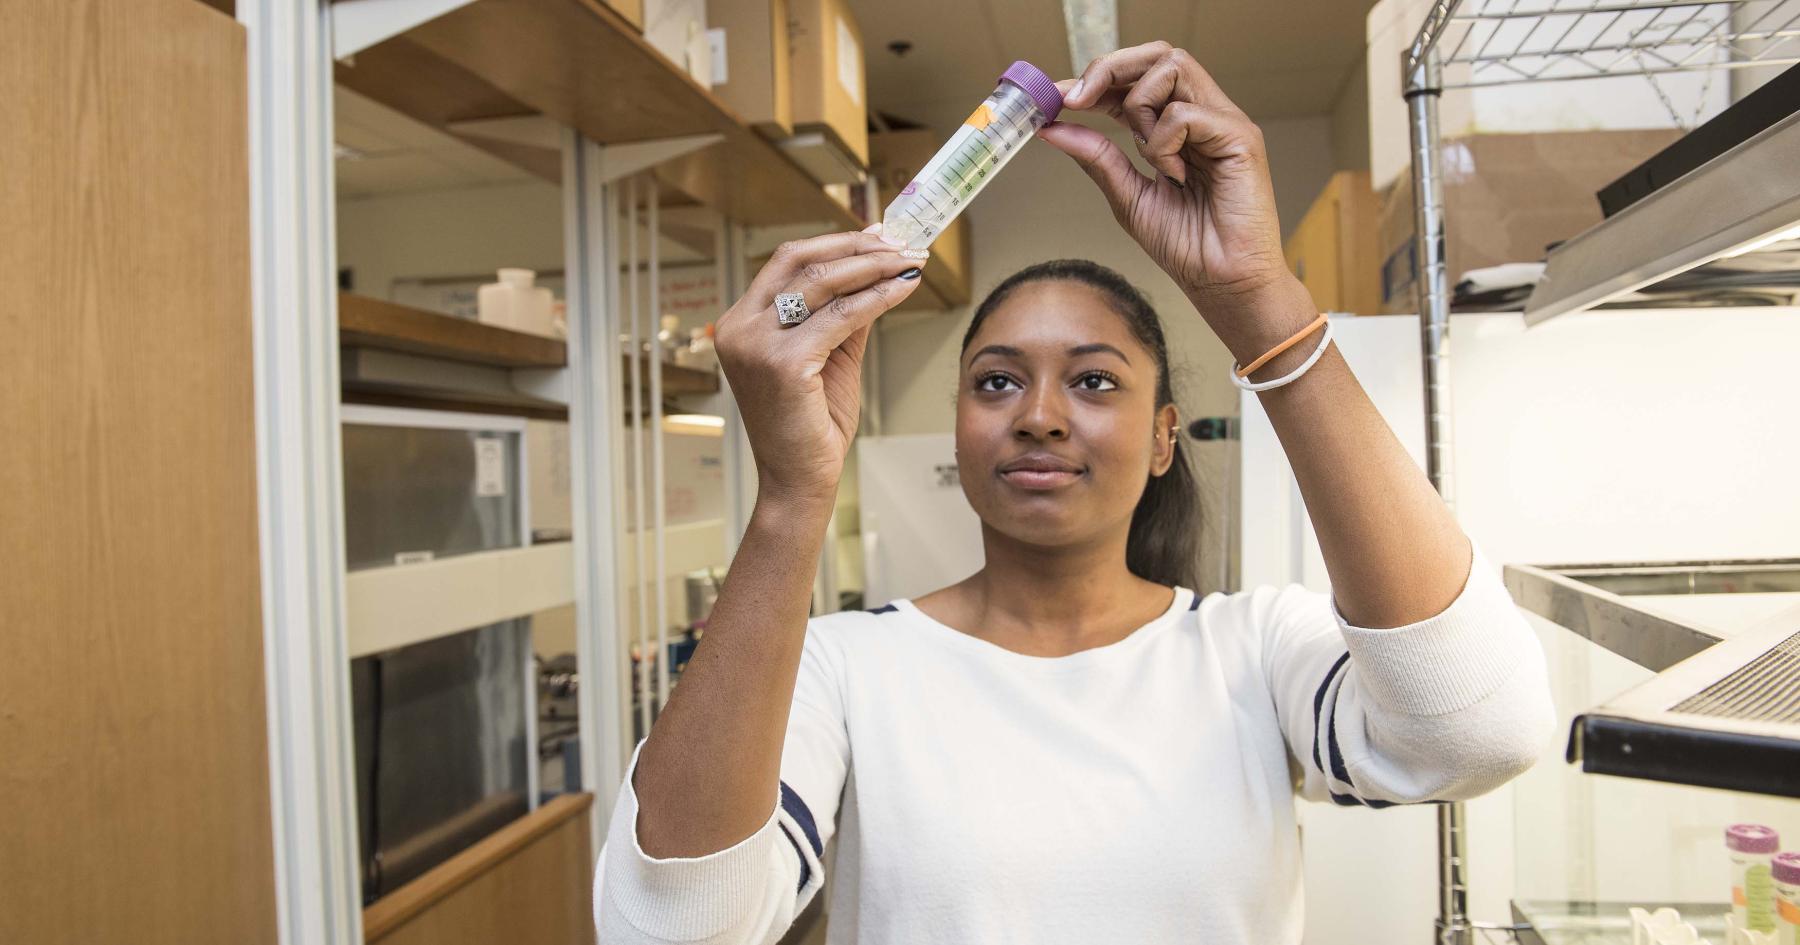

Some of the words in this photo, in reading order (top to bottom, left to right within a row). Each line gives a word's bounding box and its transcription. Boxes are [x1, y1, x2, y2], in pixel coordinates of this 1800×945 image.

[951, 197, 960, 207] 15
[937, 212, 946, 221] 10
[922, 227, 932, 238] 5.0
